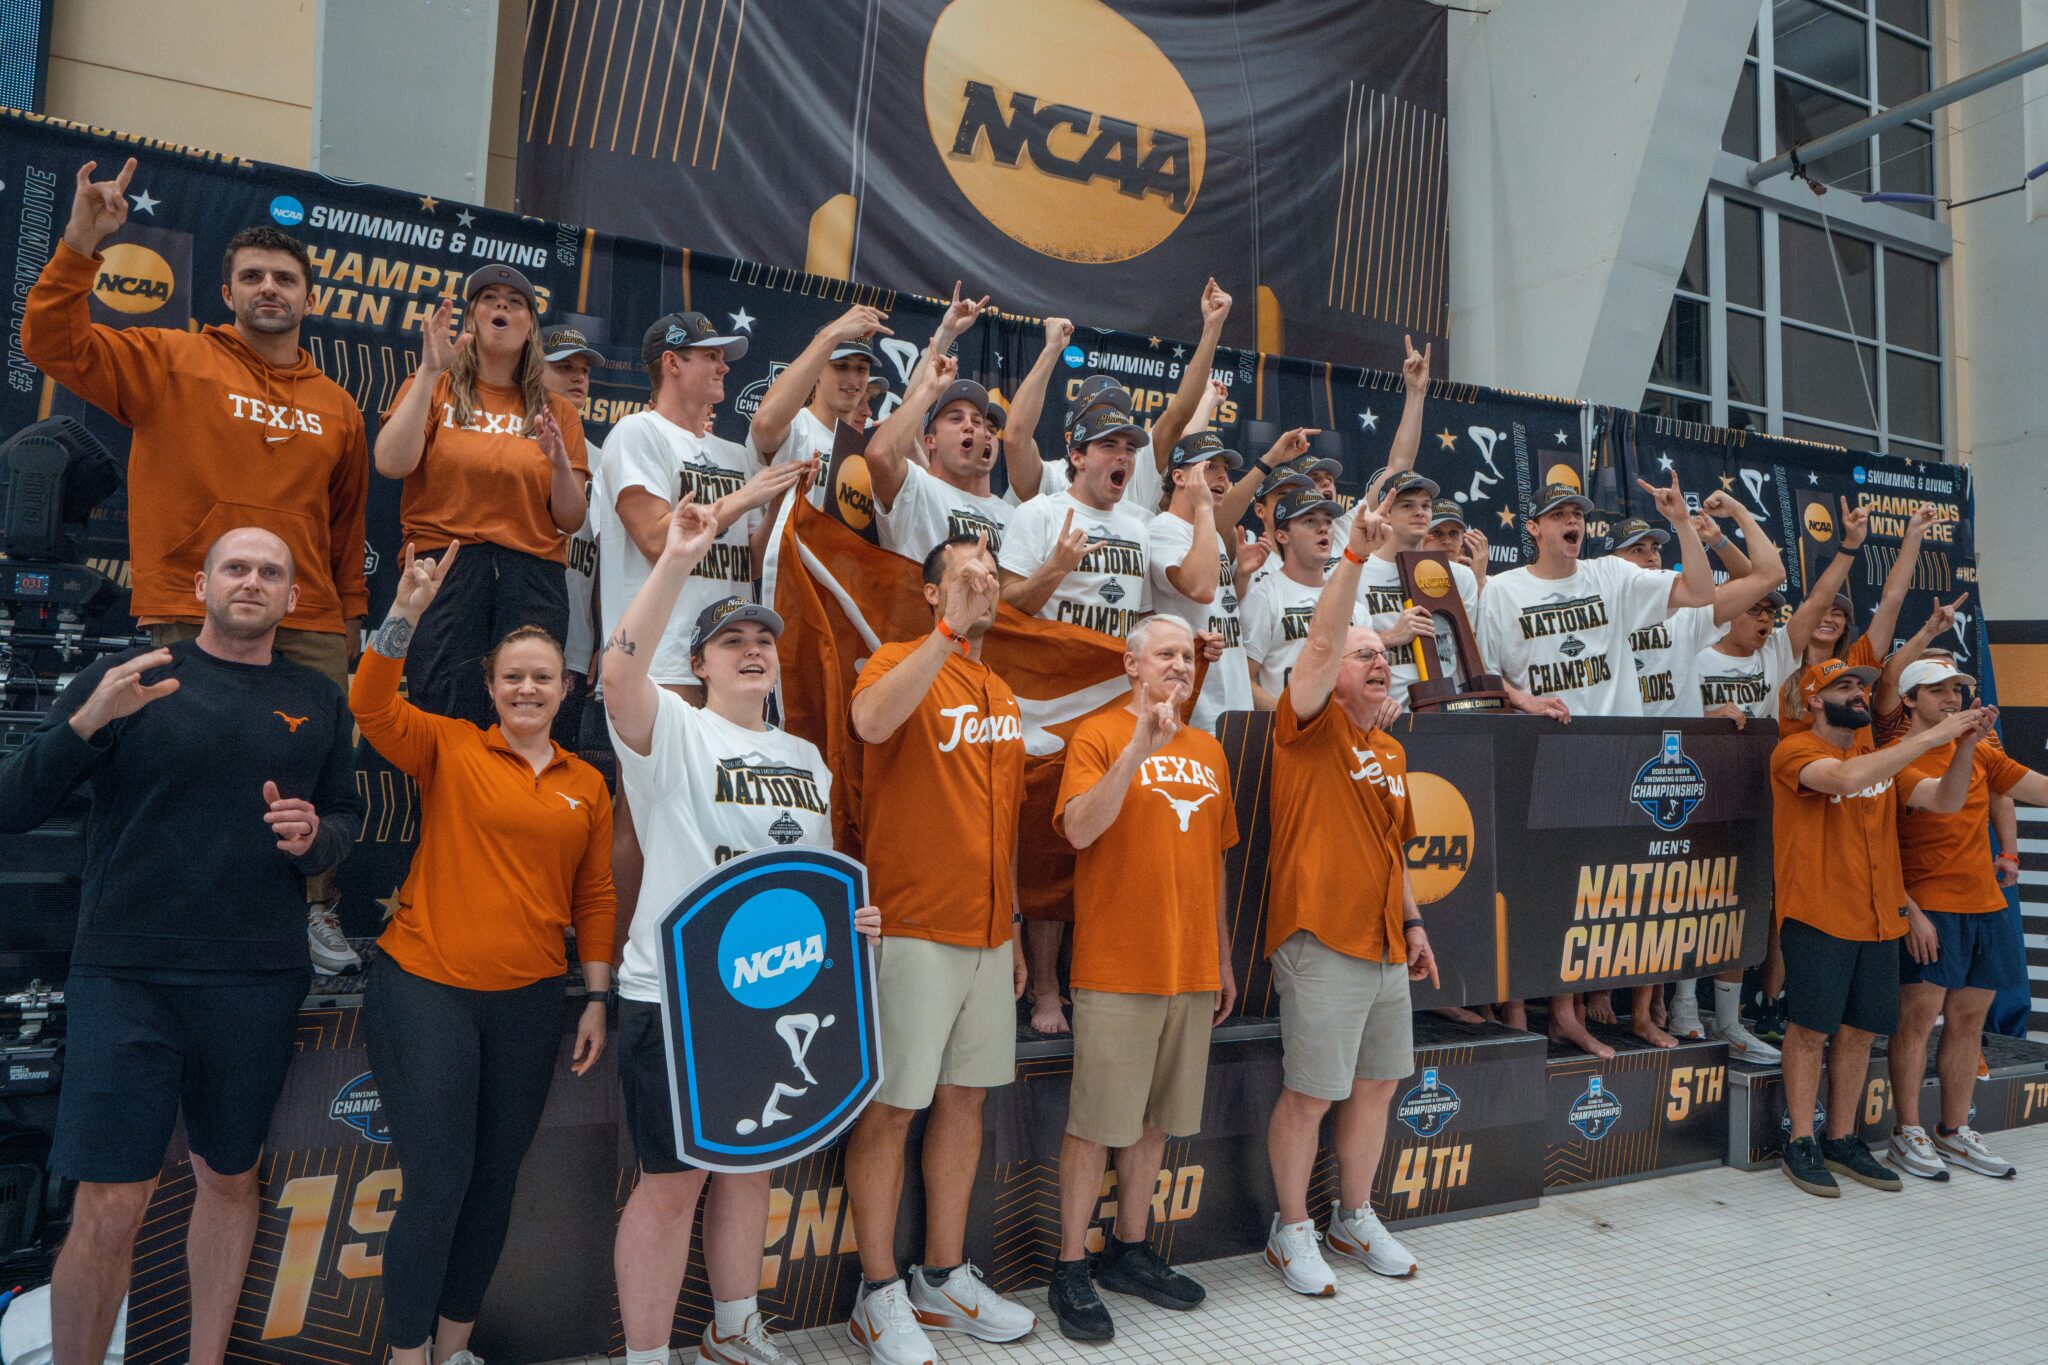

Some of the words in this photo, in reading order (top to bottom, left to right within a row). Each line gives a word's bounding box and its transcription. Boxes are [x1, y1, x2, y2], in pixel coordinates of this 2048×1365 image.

[950, 80, 1196, 214] NCAA
[272, 207, 303, 221] NCAA
[309, 205, 444, 249] SWIMMING
[449, 232, 466, 253] &
[471, 236, 548, 268] DIVING
[96, 271, 169, 302] NCAA
[306, 245, 550, 315] HAMPIS
[1065, 354, 1085, 363] NCAA
[1168, 363, 1180, 379] &
[229, 394, 323, 435] TEXAS
[443, 403, 537, 440] TEXA
[1867, 470, 1914, 488] SWIMMING
[1918, 476, 1924, 489] &
[1925, 479, 1953, 494] DIVING
[839, 482, 874, 519] NCAA
[1858, 493, 1960, 522] CHAMPNS
[1809, 519, 1833, 533] NCAA
[1870, 515, 1905, 537] WIN
[1925, 523, 1954, 542] ERE
[1073, 546, 1145, 579] ATIONAL
[1488, 545, 1518, 563] VING
[1518, 601, 1609, 640] NATIONAL
[1628, 627, 1673, 652] ONAL
[1447, 701, 1474, 711] NATIONAL
[1700, 678, 1771, 705] NATIONA
[715, 764, 828, 816] NATIONAL
[1139, 755, 1220, 795] TEXAS
[1633, 783, 1704, 798] CHAMPIONSHIPS
[1402, 835, 1468, 871] CAA
[1649, 840, 1690, 856] MEN'S
[1574, 856, 1738, 921] NATIONAL
[732, 934, 824, 989] NCAA
[1560, 909, 1746, 983] CHAMPION
[350, 1091, 379, 1099] SWIM
[1399, 1101, 1459, 1117] CHAMPIONSHIPS
[1667, 1065, 1725, 1122] 5TH
[1570, 1107, 1620, 1121] CHAMPIONSHIPS
[1391, 1144, 1473, 1210] 4TH
[261, 1168, 403, 1341] 1S
